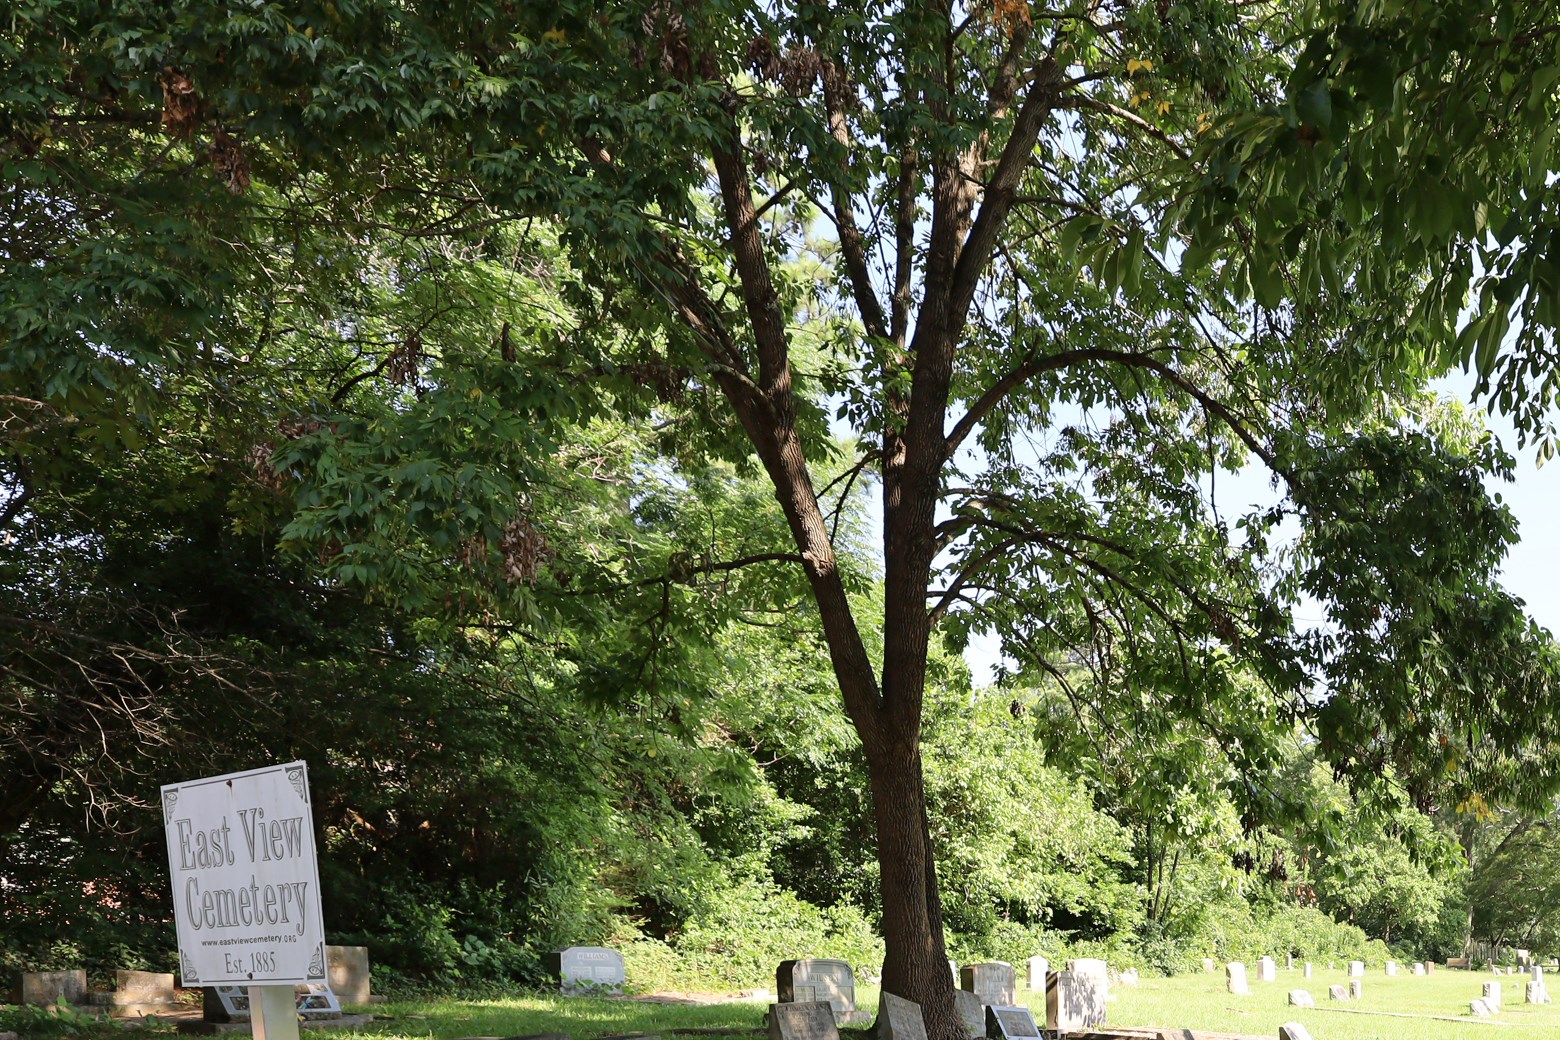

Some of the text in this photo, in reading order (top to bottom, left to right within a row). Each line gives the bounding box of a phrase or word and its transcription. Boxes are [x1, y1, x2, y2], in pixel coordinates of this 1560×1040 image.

[174, 807, 303, 871] East View
[186, 874, 308, 936] Cemetery
[201, 936, 297, 946] www.eastviewcemetery.ORG
[224, 951, 276, 974] Est. 1885
